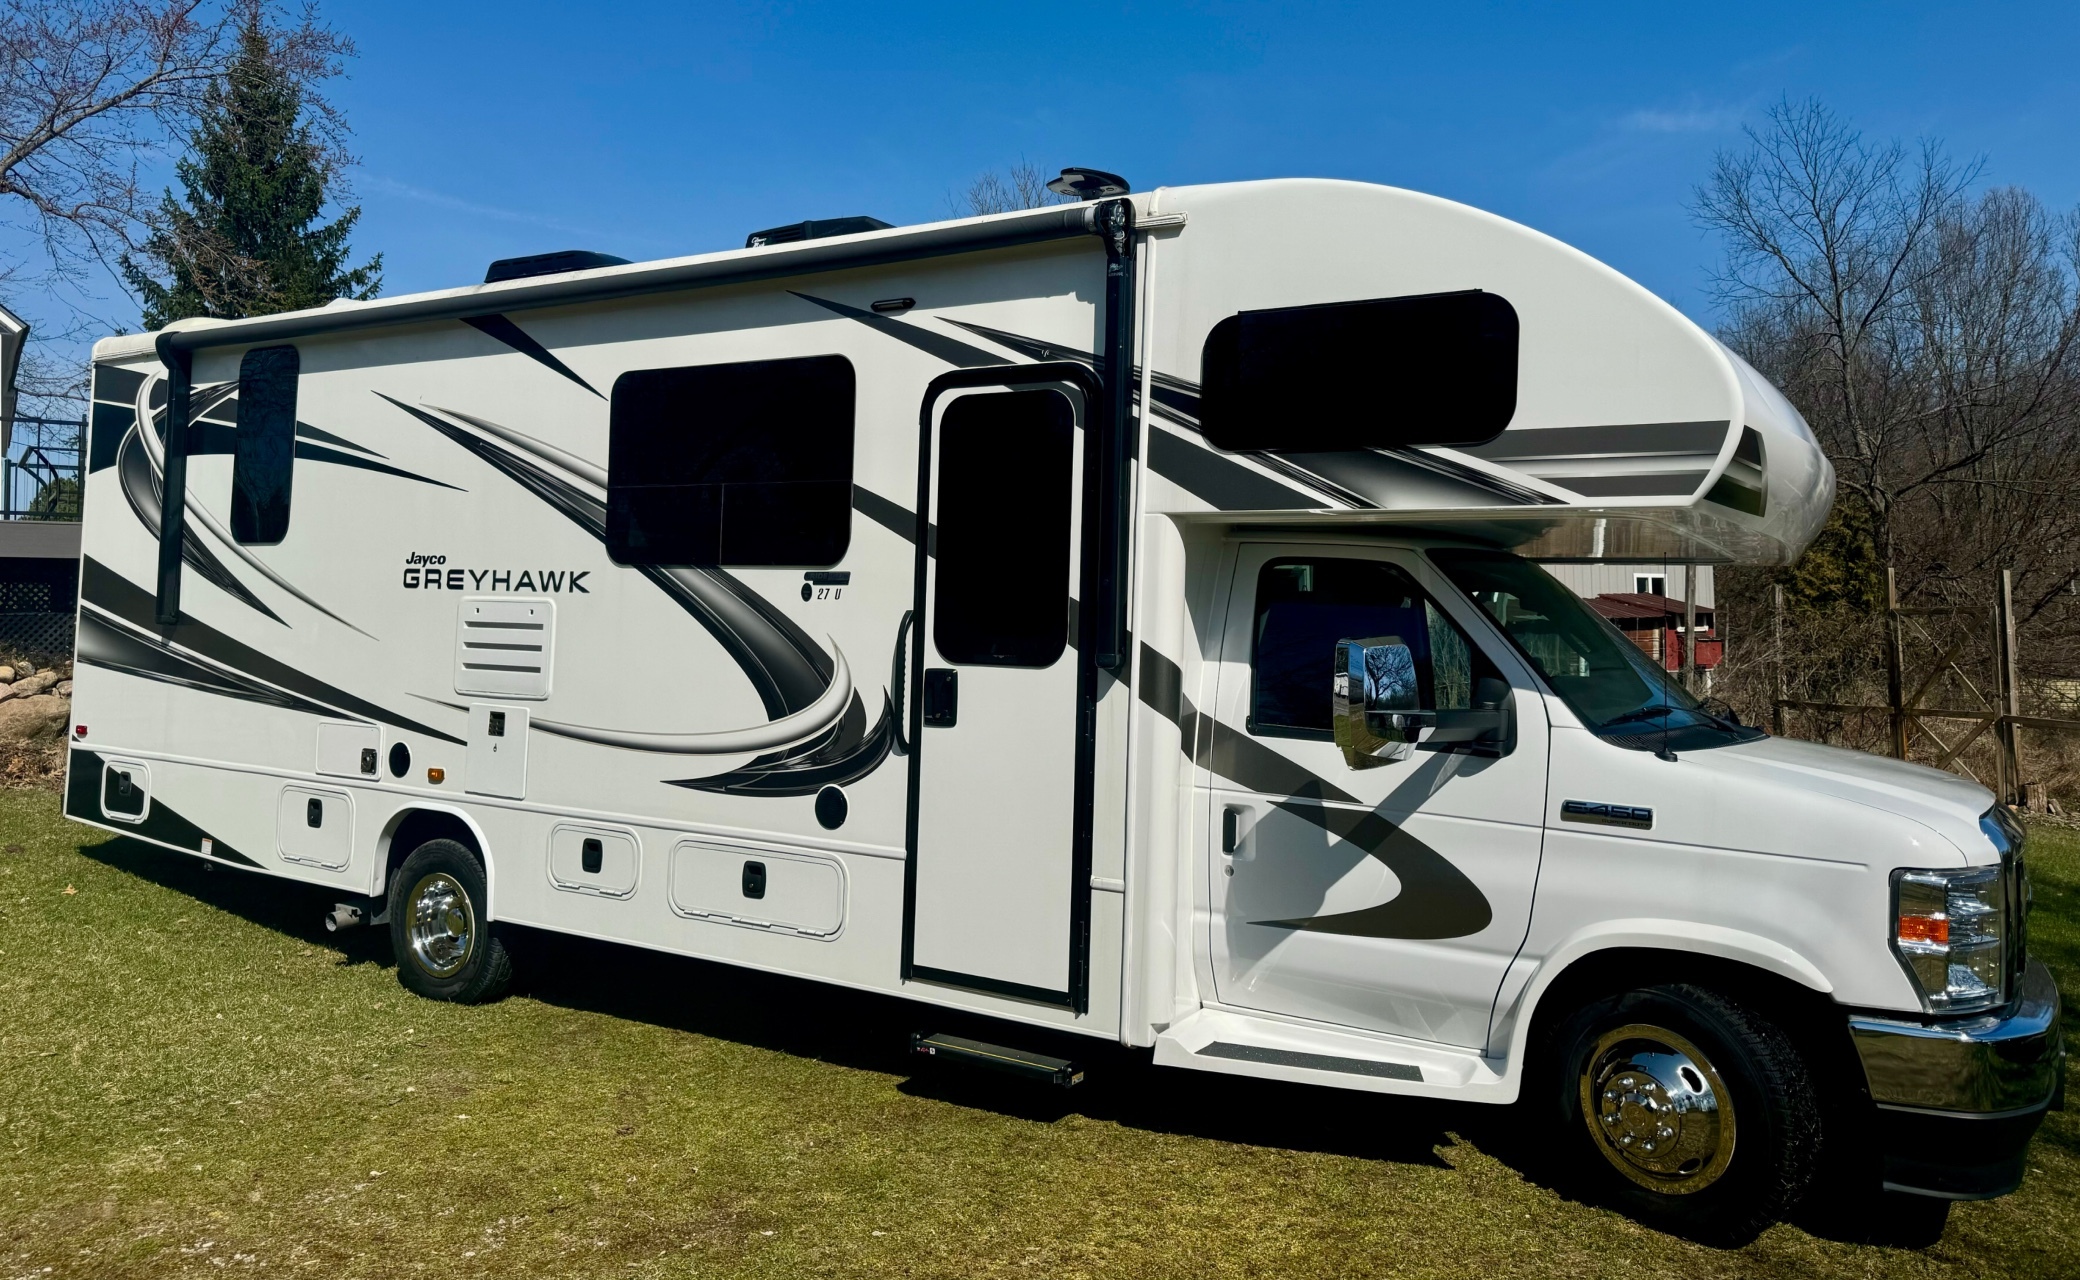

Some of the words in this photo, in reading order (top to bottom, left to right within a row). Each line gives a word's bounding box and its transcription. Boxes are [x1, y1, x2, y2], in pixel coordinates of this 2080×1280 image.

[405, 551, 447, 567] Jayco
[403, 568, 591, 593] GREYHAWK
[817, 588, 830, 600] 27
[834, 588, 842, 600] U
